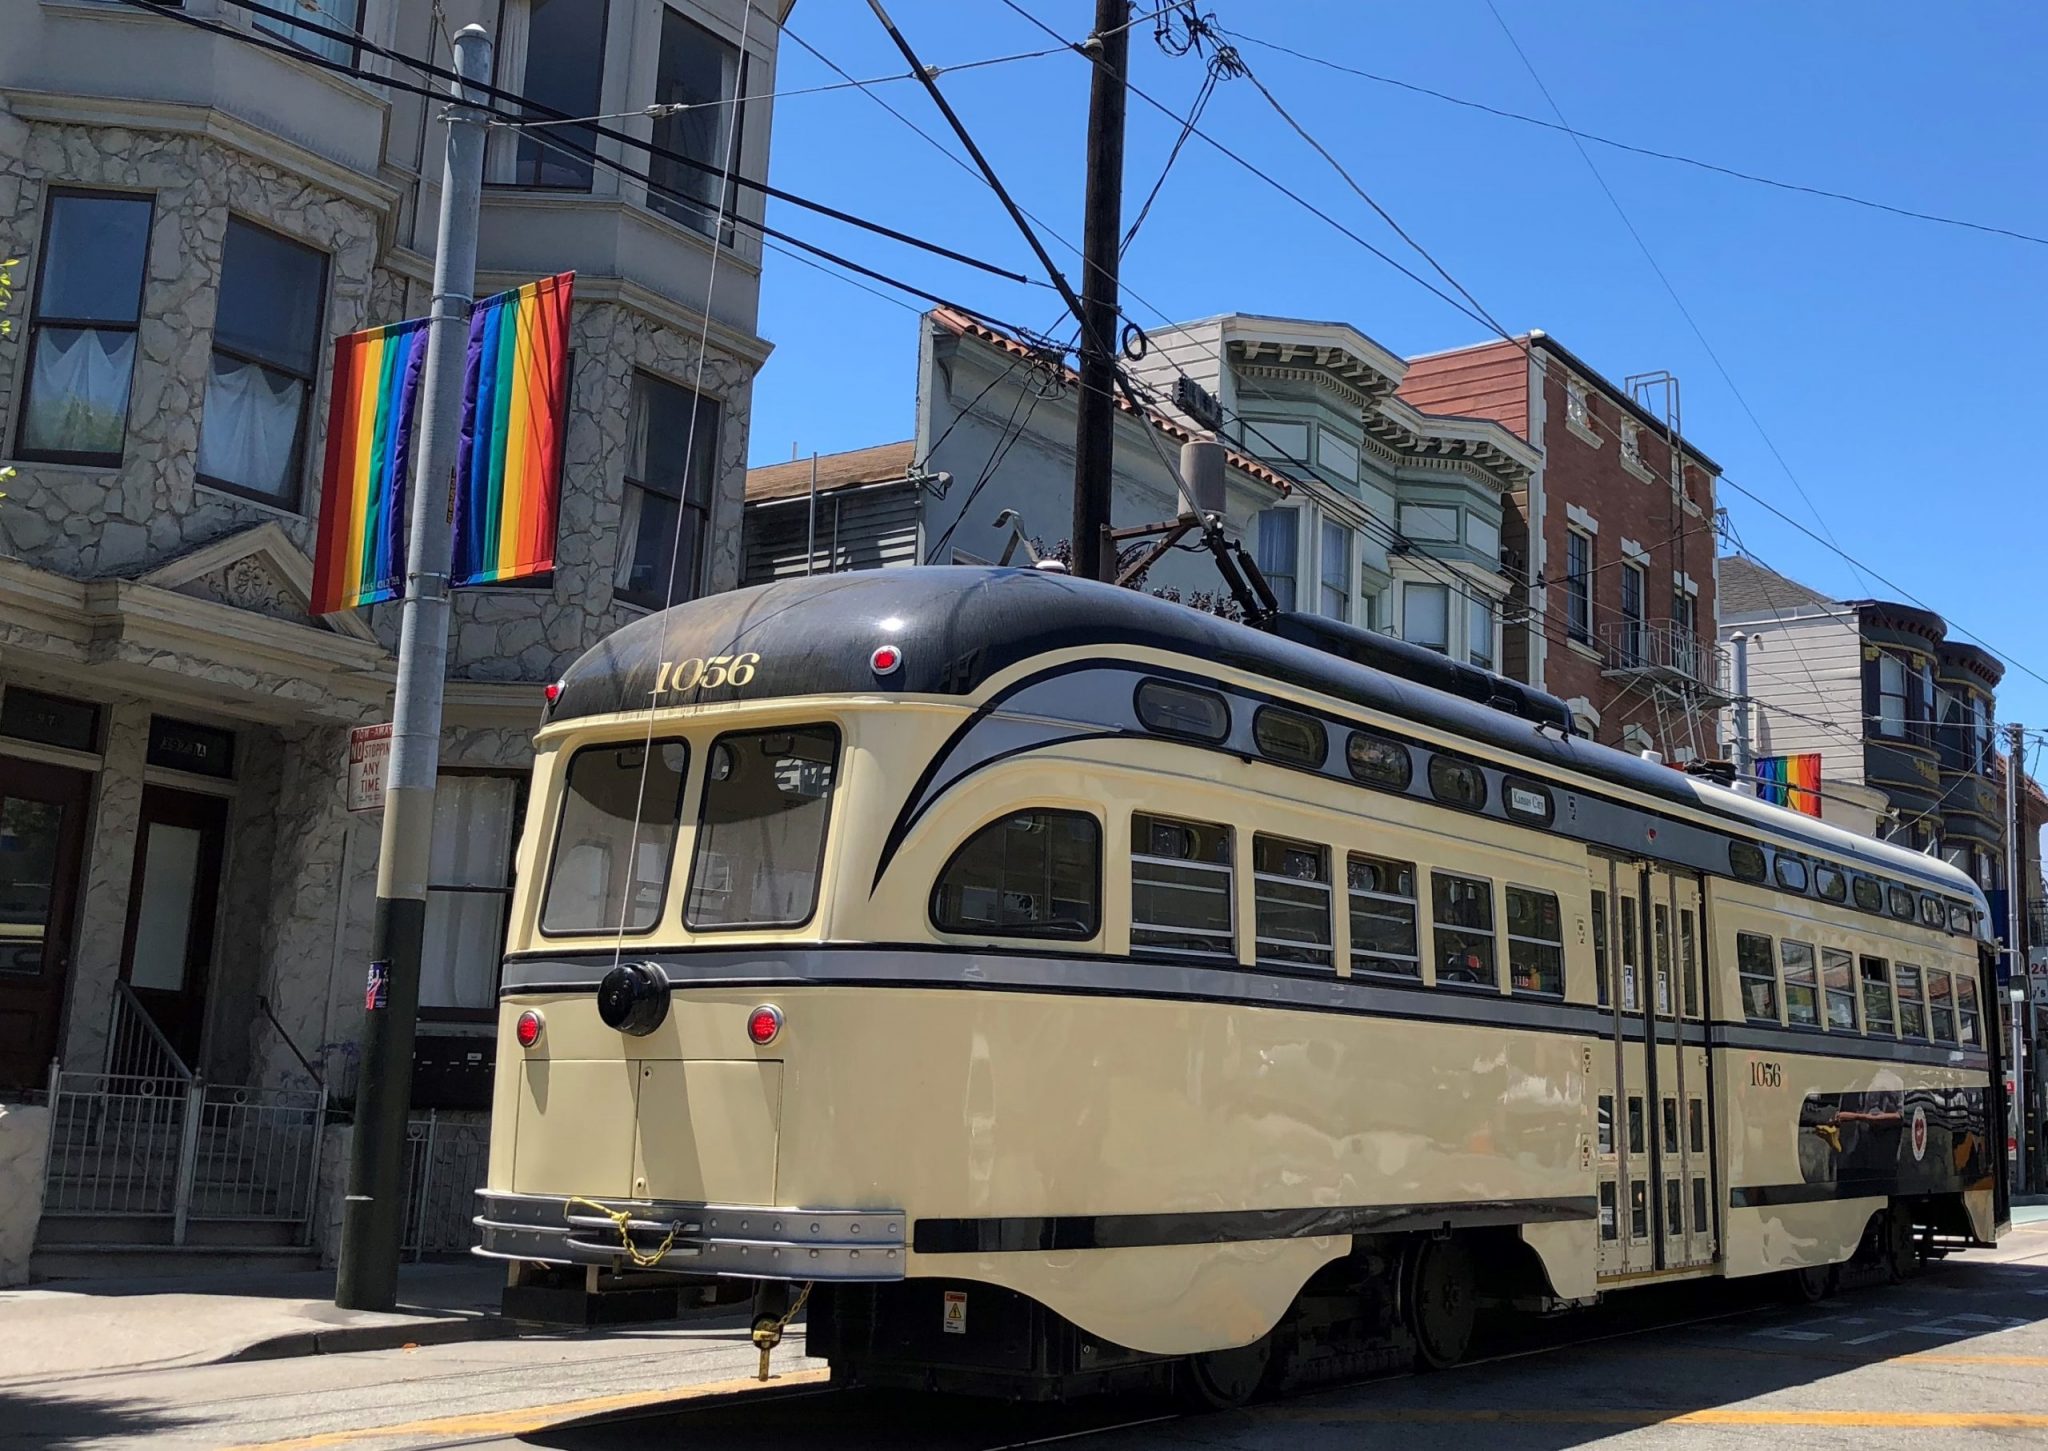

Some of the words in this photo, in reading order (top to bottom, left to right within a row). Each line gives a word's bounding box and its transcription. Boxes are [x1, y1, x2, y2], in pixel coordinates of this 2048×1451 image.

[647, 652, 760, 694] 1056
[351, 741, 364, 761] NO
[364, 742, 391, 758] STOPPIN
[362, 761, 380, 776] ANY
[360, 777, 380, 793] TIME
[1751, 1061, 1781, 1088] 1056
